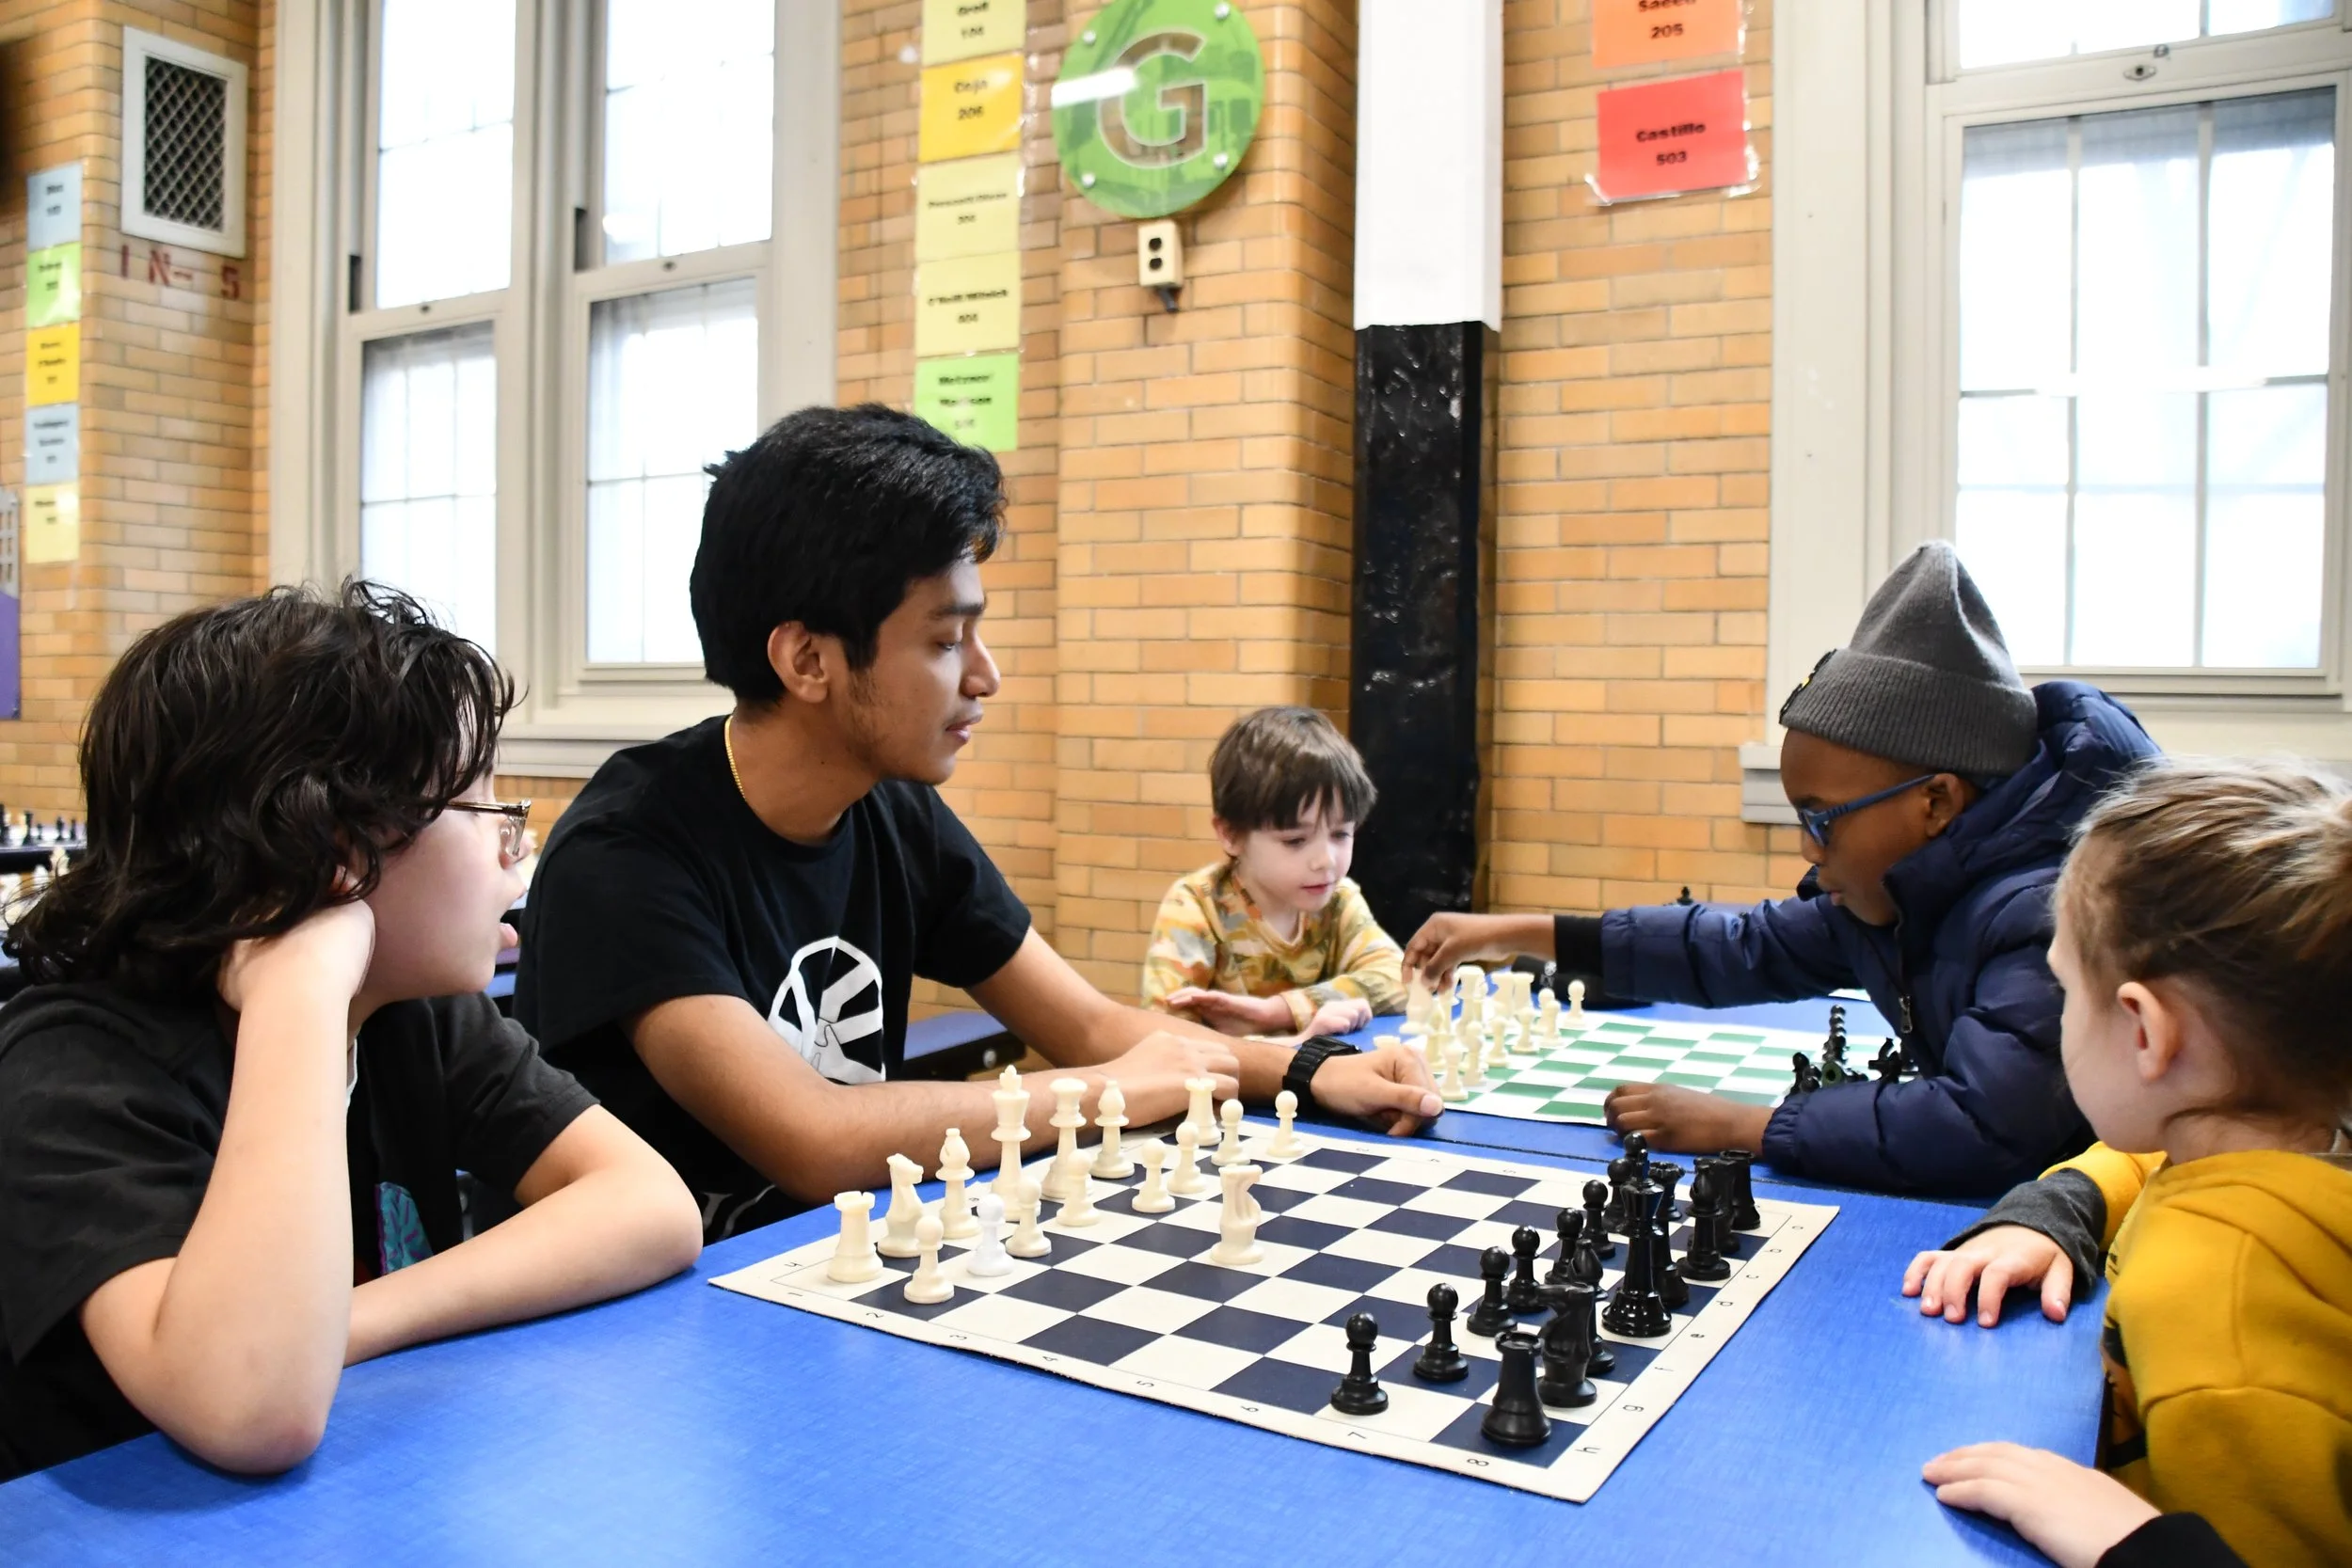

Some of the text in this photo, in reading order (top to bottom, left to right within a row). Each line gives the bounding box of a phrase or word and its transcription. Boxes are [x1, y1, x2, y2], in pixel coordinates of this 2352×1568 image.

[1651, 24, 1683, 39] 205
[1097, 29, 1206, 167] G
[1636, 122, 1706, 142] Castillo
[1656, 150, 1688, 166] 503
[1466, 1458, 1489, 1467] 8
